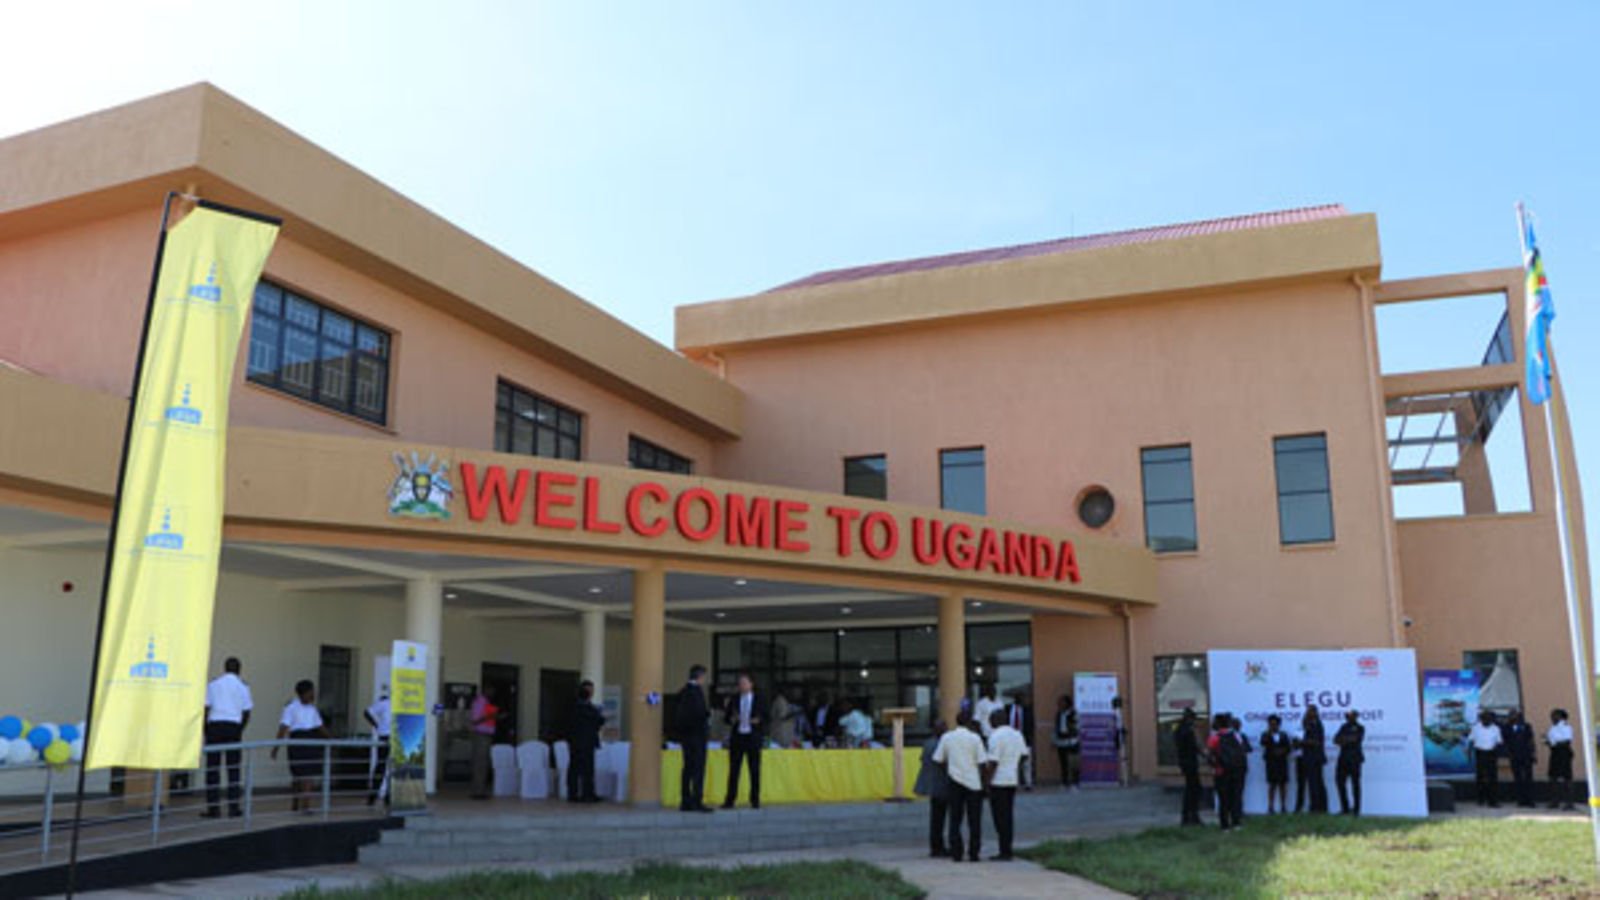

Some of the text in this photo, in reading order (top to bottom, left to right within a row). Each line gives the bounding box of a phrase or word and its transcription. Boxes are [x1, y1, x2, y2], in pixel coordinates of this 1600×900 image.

[459, 461, 1082, 585] WELCOME TO UGANDA
[1274, 691, 1352, 709] ELEGU
